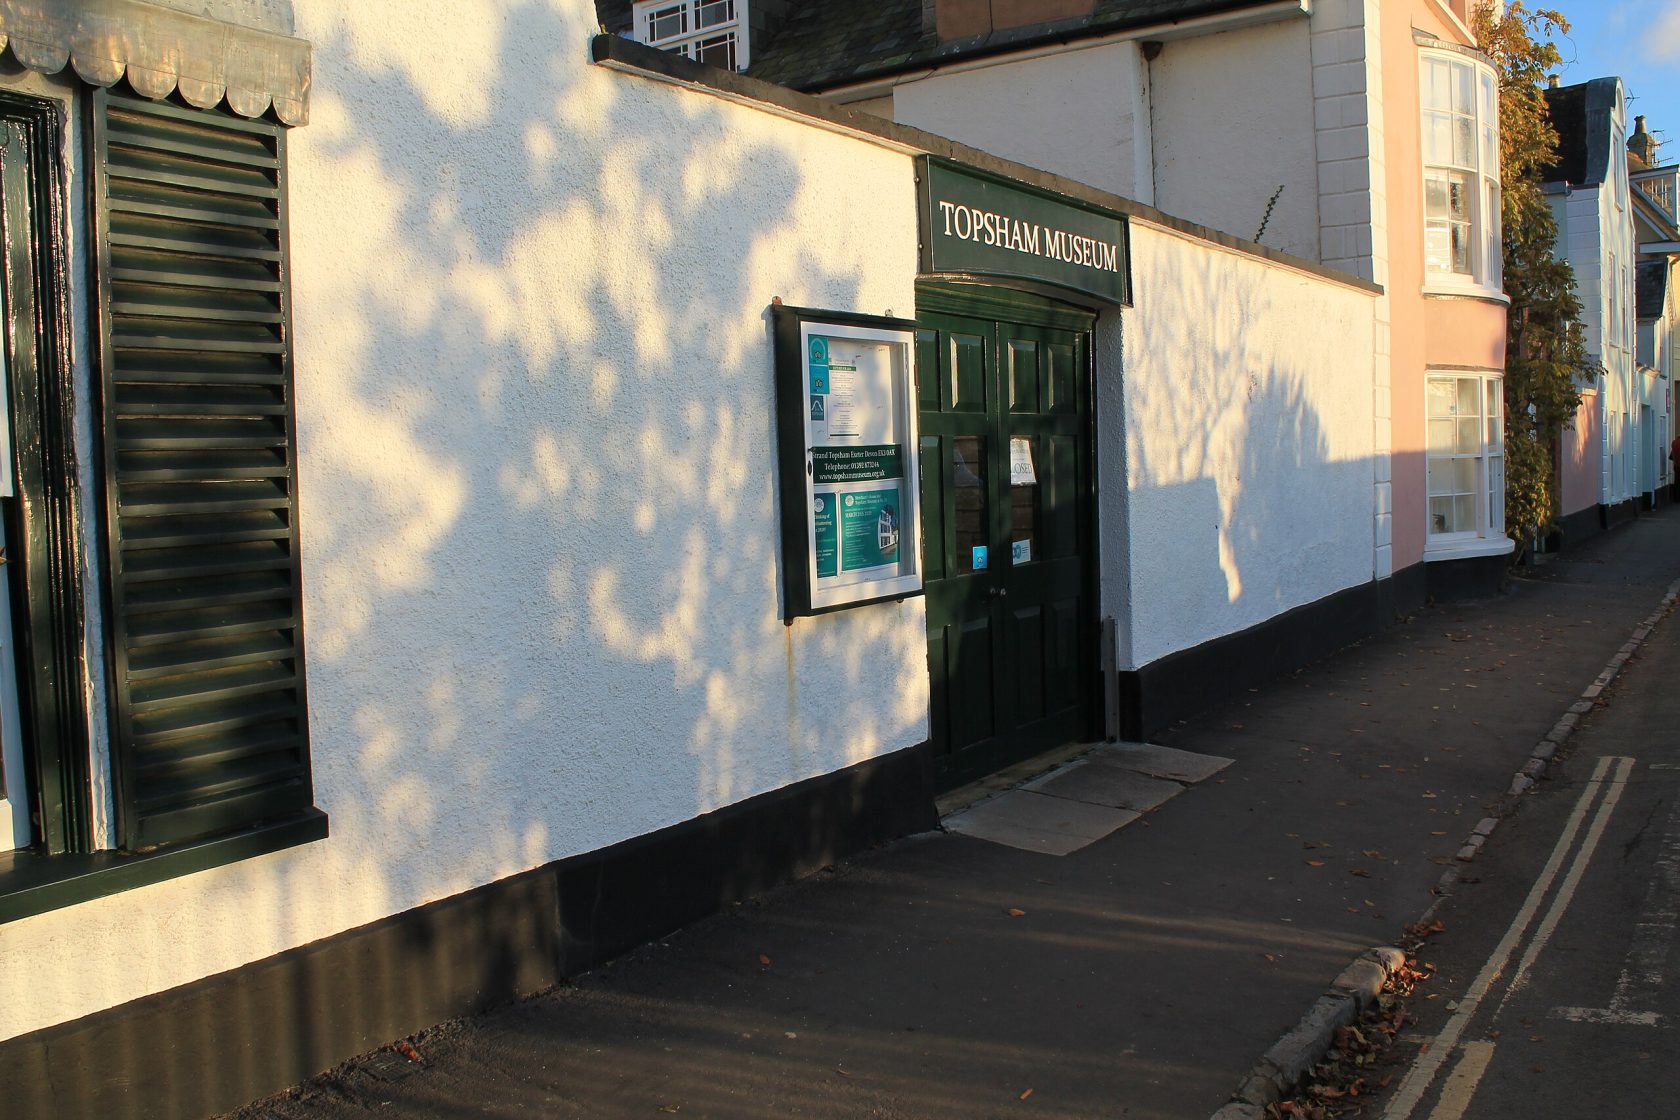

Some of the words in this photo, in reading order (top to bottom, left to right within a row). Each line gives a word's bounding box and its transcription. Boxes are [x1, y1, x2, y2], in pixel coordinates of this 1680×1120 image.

[939, 200, 1040, 256] TOPSHAM
[1043, 227, 1118, 273] MUSEUM
[829, 451, 850, 460] Topsham
[864, 450, 878, 458] Devon
[851, 462, 864, 470] 01392
